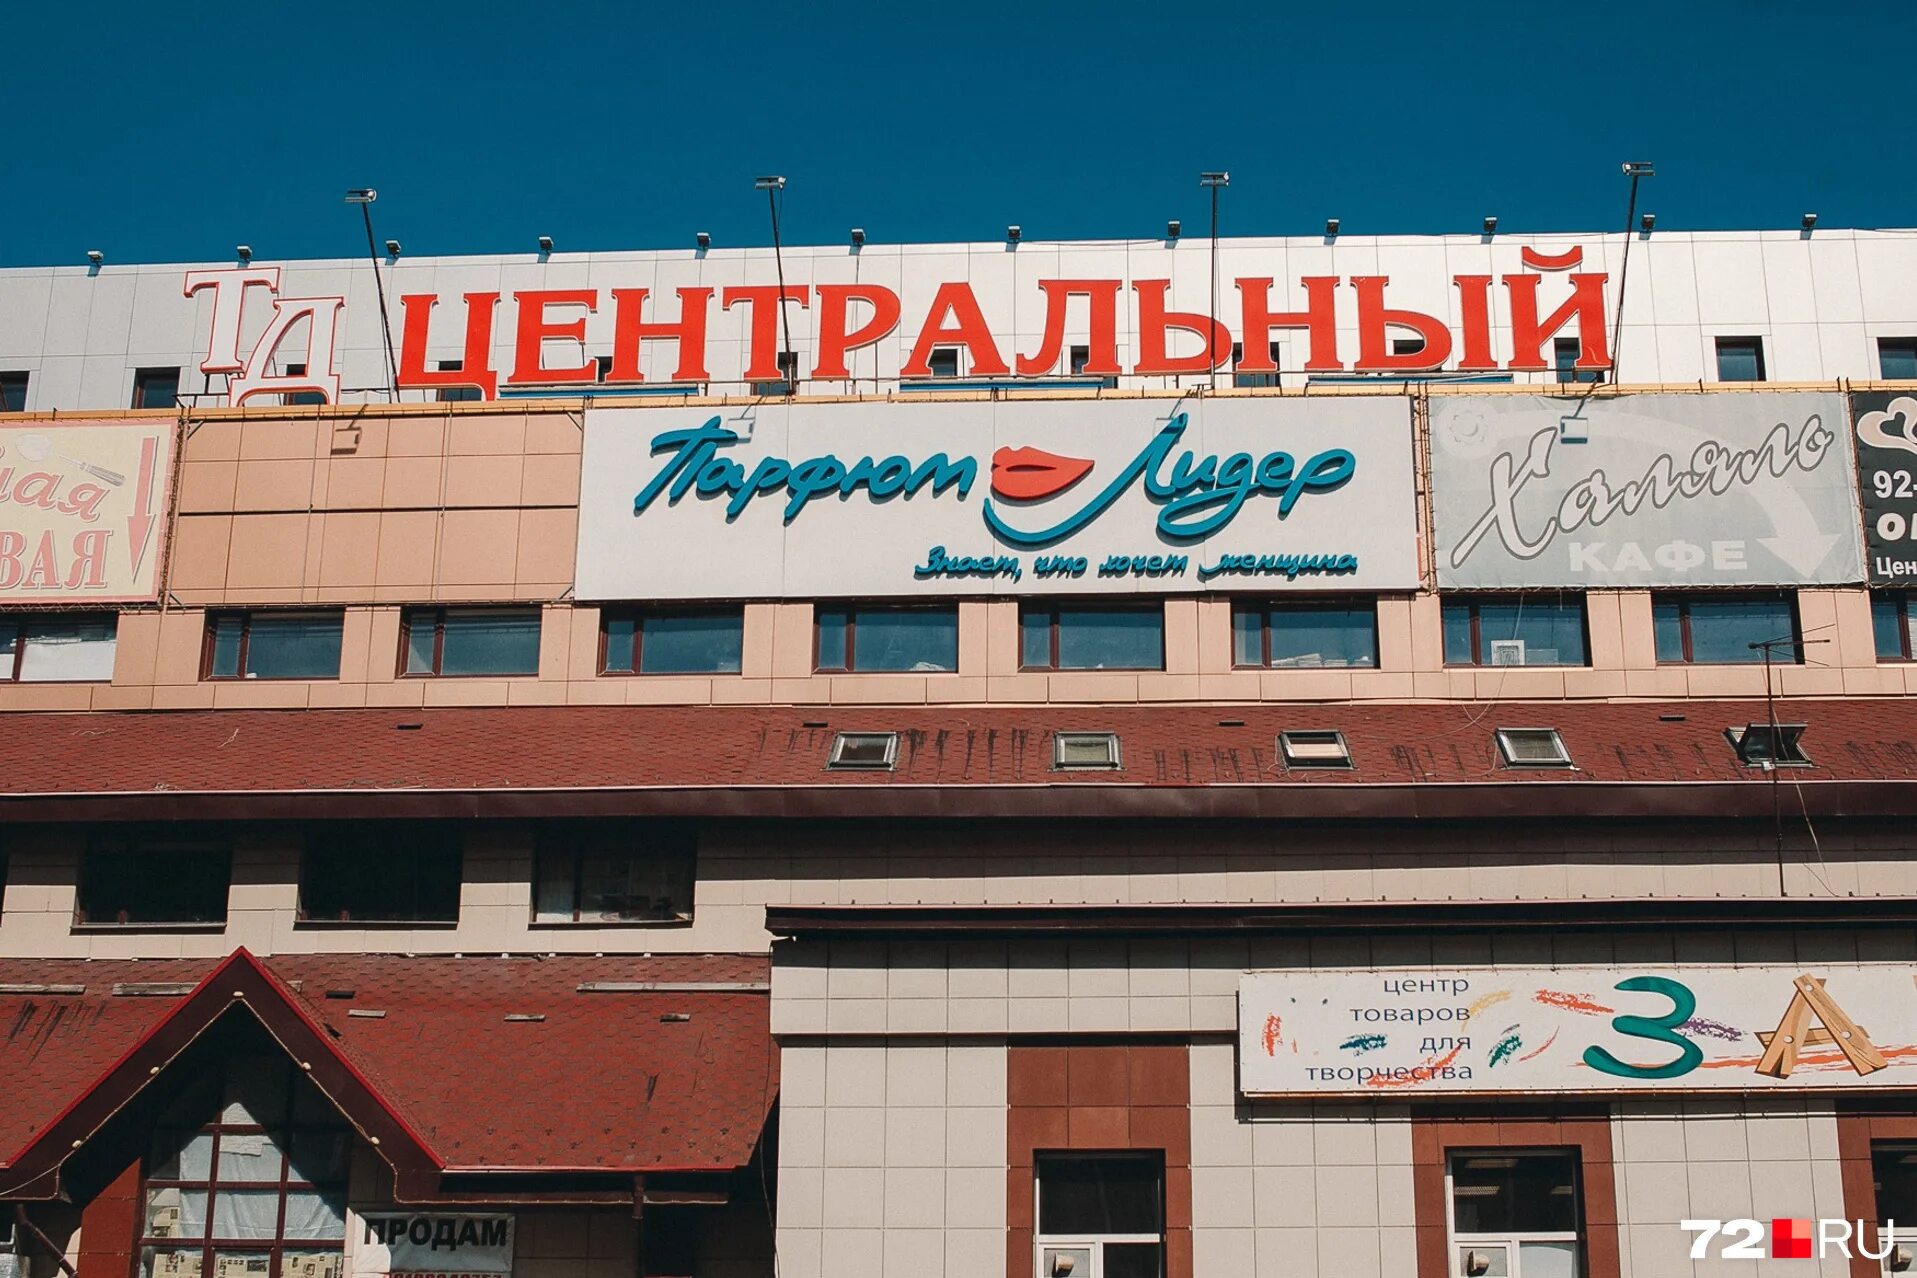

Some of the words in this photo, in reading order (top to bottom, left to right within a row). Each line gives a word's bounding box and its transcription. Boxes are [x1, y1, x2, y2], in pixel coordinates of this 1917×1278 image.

[183, 267, 344, 406] ТД
[397, 245, 1615, 402] ЦЕНТРАЛЬНЫЙ
[634, 415, 979, 523] Парфюм
[983, 413, 1357, 542] Лидер
[915, 545, 1023, 582] Знает,
[1034, 554, 1088, 576] что
[1098, 552, 1189, 577] хочет
[1198, 552, 1358, 582] женщина
[1567, 538, 1749, 573] КАФЕ
[1384, 978, 1469, 996] центр
[1350, 1007, 1471, 1025] товаров
[1419, 1036, 1471, 1053] для
[1305, 1066, 1472, 1085] творчества
[363, 1216, 508, 1252] ПРОДАМ
